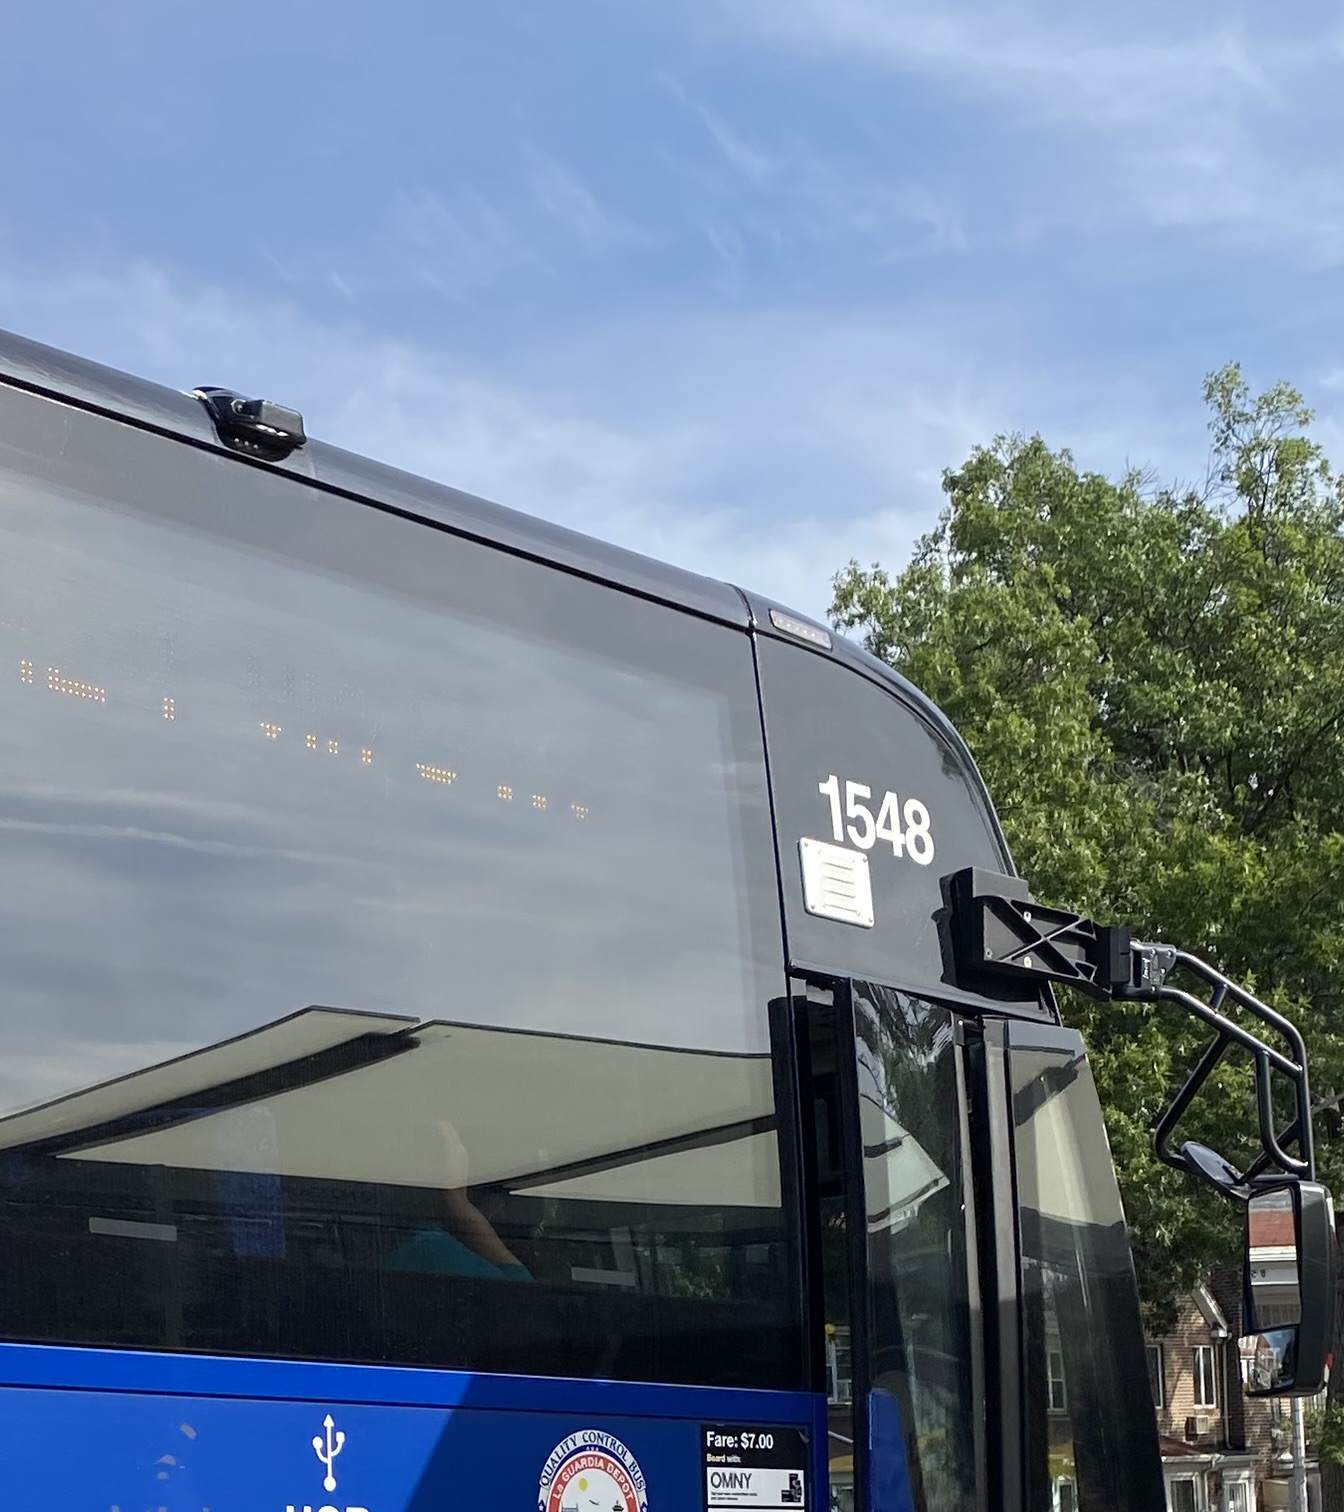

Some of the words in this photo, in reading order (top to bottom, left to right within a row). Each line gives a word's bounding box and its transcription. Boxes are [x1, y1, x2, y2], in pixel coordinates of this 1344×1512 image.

[818, 774, 935, 866] 1548
[540, 1434, 578, 1487] QUALITY
[582, 1431, 629, 1462] CONTROL
[628, 1459, 646, 1490] BUS
[706, 1431, 739, 1448] Fare:
[740, 1432, 774, 1450] $7.00
[562, 1456, 605, 1483] GUARDIA
[606, 1461, 635, 1501] DEPOT
[710, 1471, 752, 1489] OMNY
